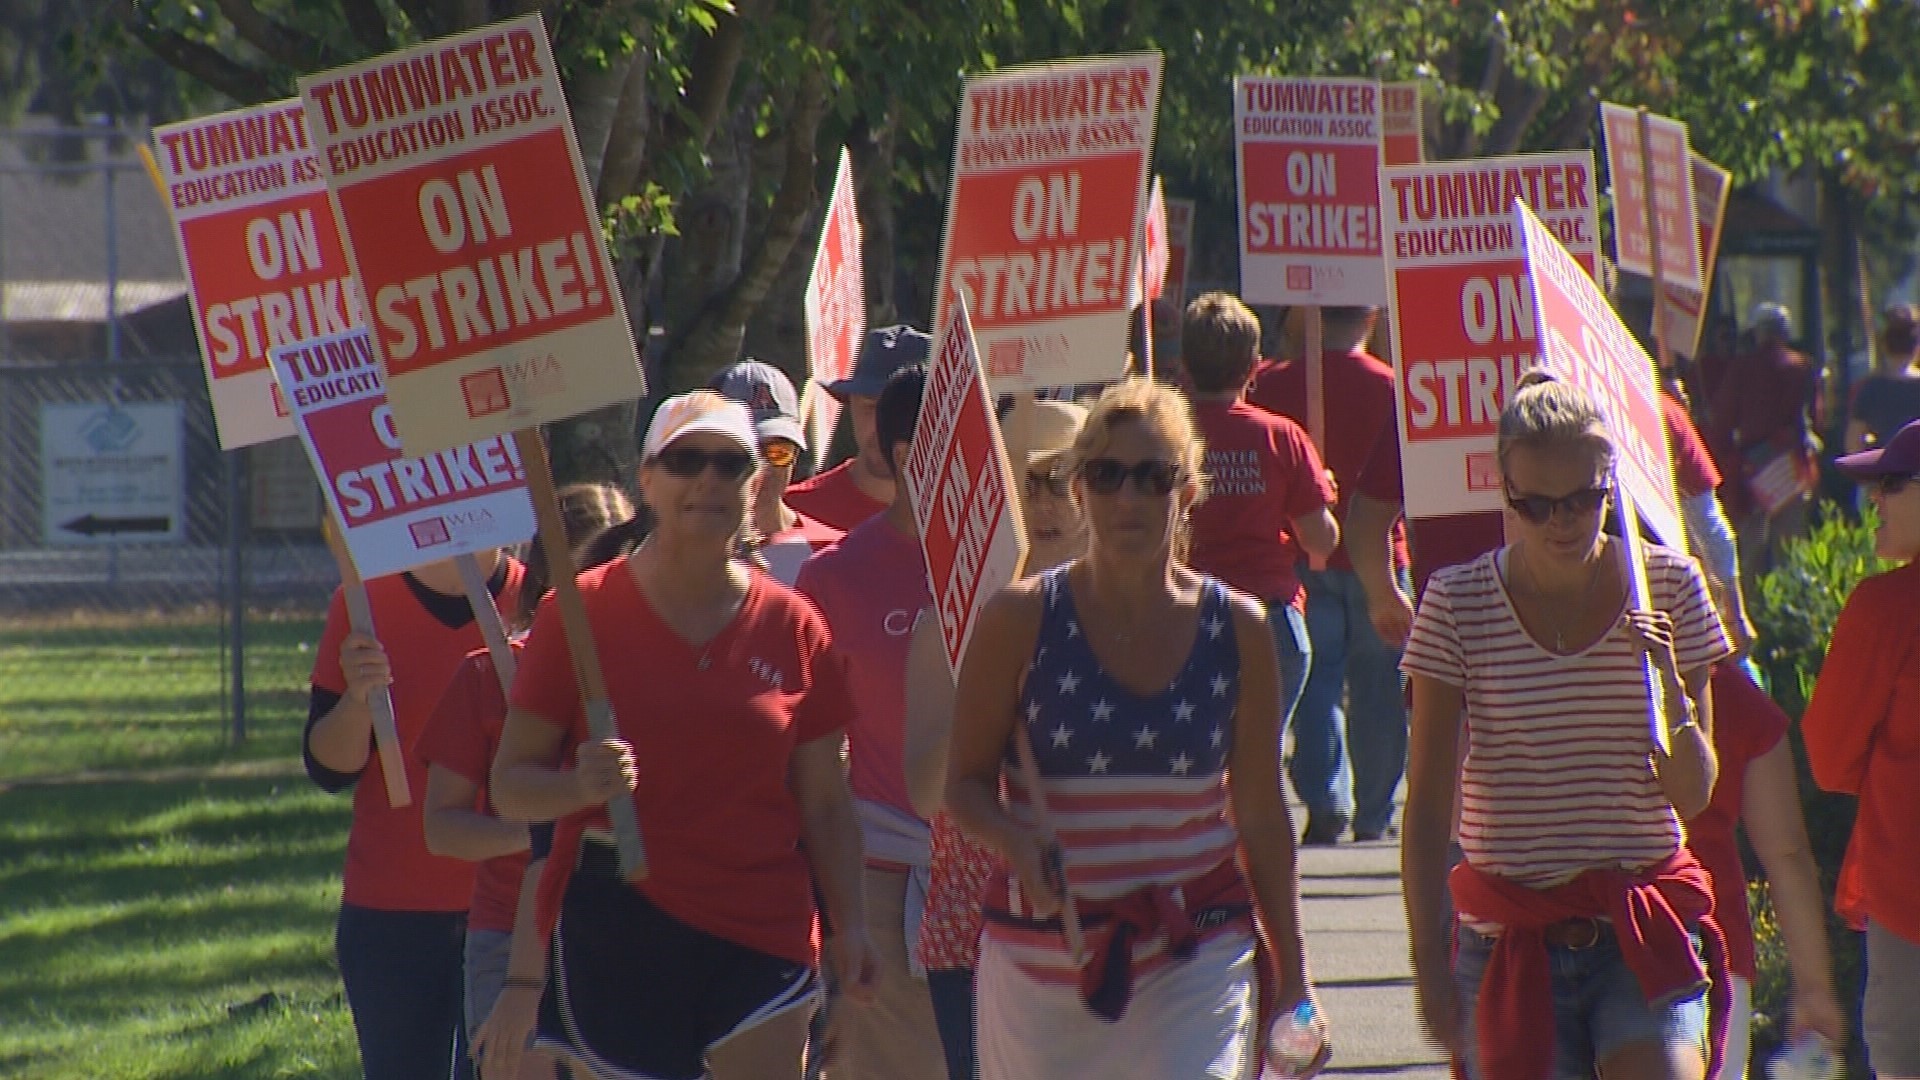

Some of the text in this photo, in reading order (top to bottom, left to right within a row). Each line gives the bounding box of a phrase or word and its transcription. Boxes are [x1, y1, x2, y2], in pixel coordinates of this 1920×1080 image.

[309, 28, 543, 136] TUMWATER
[969, 66, 1148, 129] TUMWATER
[1243, 82, 1376, 115] TUMWATER
[162, 106, 308, 176] TUMWAT
[325, 111, 465, 177] EDUCATION
[471, 88, 556, 137] ASSOC.
[960, 116, 1142, 165] EDUCATION ASSOC.
[1243, 116, 1323, 137] EDUCATION
[1328, 118, 1378, 138] ASSOC.
[171, 162, 287, 209] EDUCATION
[1011, 169, 1080, 241] ON
[1286, 151, 1338, 197] ON
[1390, 162, 1589, 224] TUMWATER
[247, 208, 323, 282] ON
[418, 164, 513, 256] ON
[1248, 201, 1379, 250] STRIKE!
[1394, 222, 1514, 260] EDUCATION
[374, 232, 603, 362] STRIKE!
[947, 236, 1126, 317] STRIKE!
[1461, 275, 1536, 345] ON
[294, 371, 381, 407] EDUCATI
[1407, 353, 1530, 430] STRI
[335, 433, 526, 518] STRIKE!
[942, 438, 971, 542] ON
[1205, 449, 1258, 464] WATER
[943, 450, 1003, 652] STRIKE!
